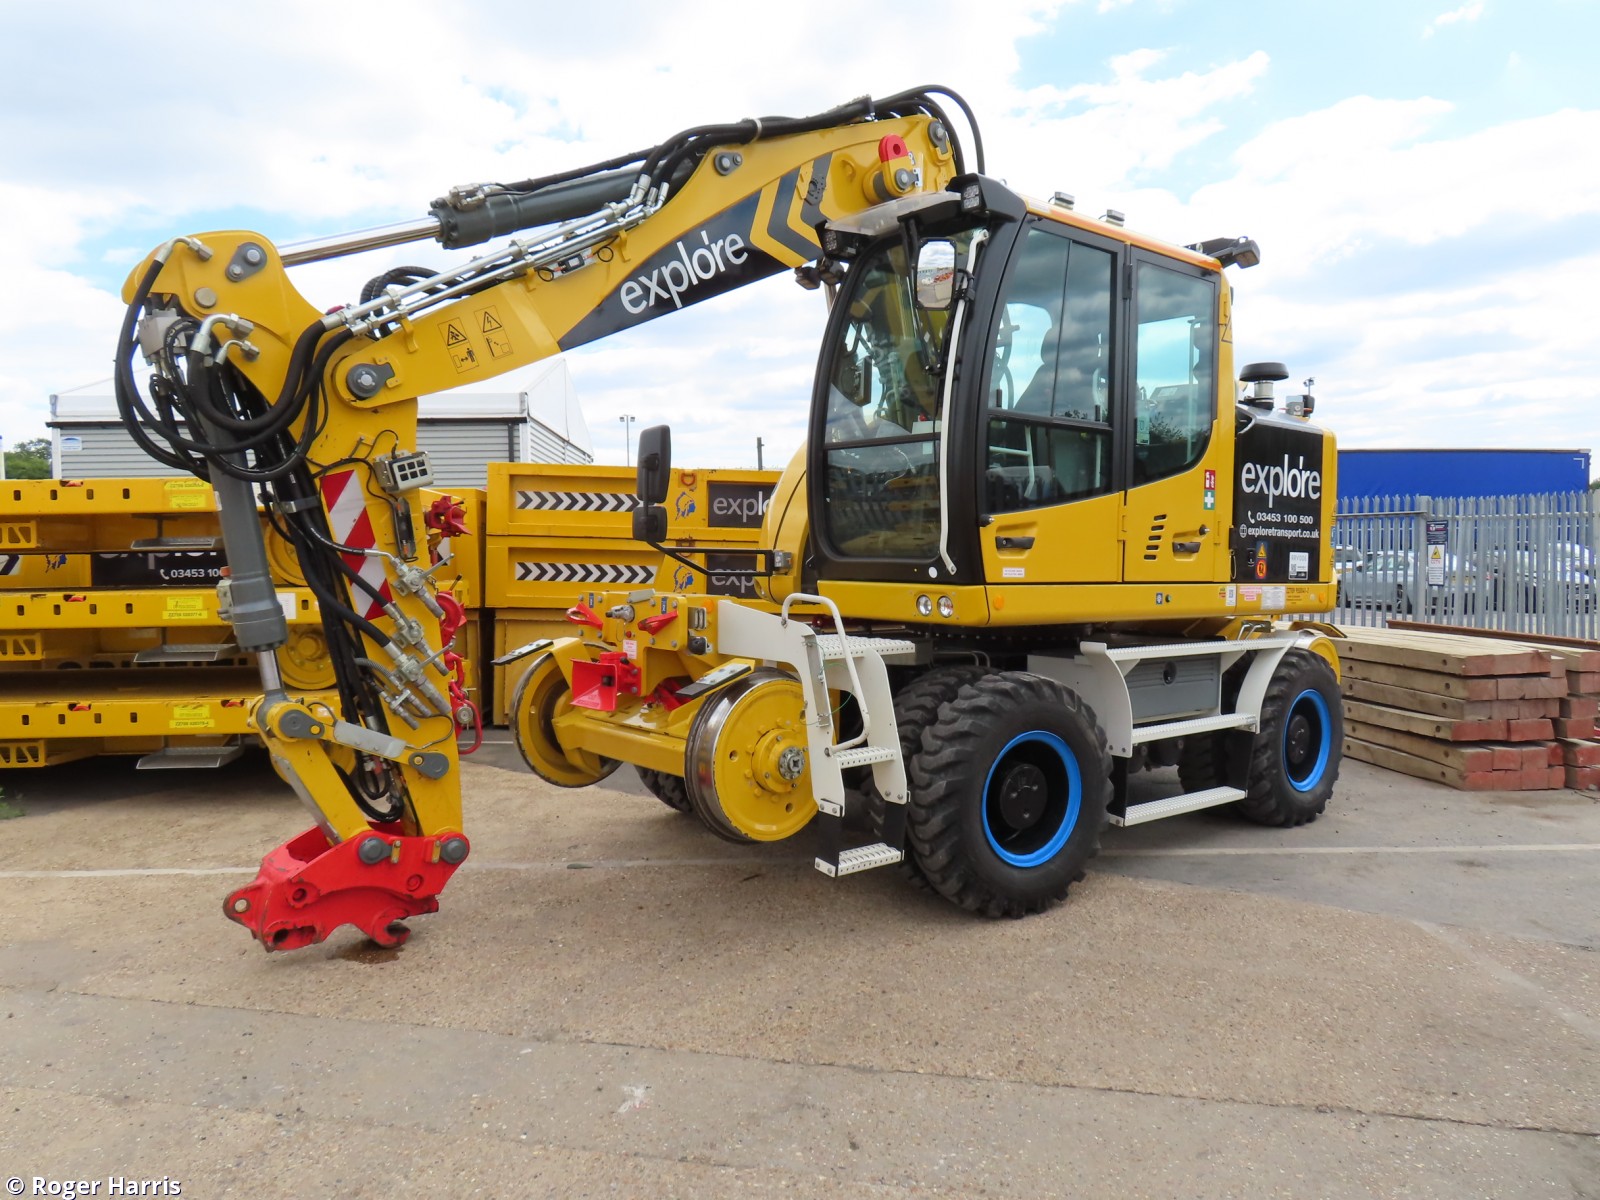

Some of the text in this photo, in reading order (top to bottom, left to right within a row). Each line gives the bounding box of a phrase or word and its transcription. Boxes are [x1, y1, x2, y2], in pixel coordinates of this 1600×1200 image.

[620, 230, 748, 315] explore
[1241, 454, 1321, 508] explore
[1256, 511, 1314, 525] 03453 100 500
[1248, 525, 1320, 539] exploretransport.co.uk
[170, 568, 205, 578] 03453
